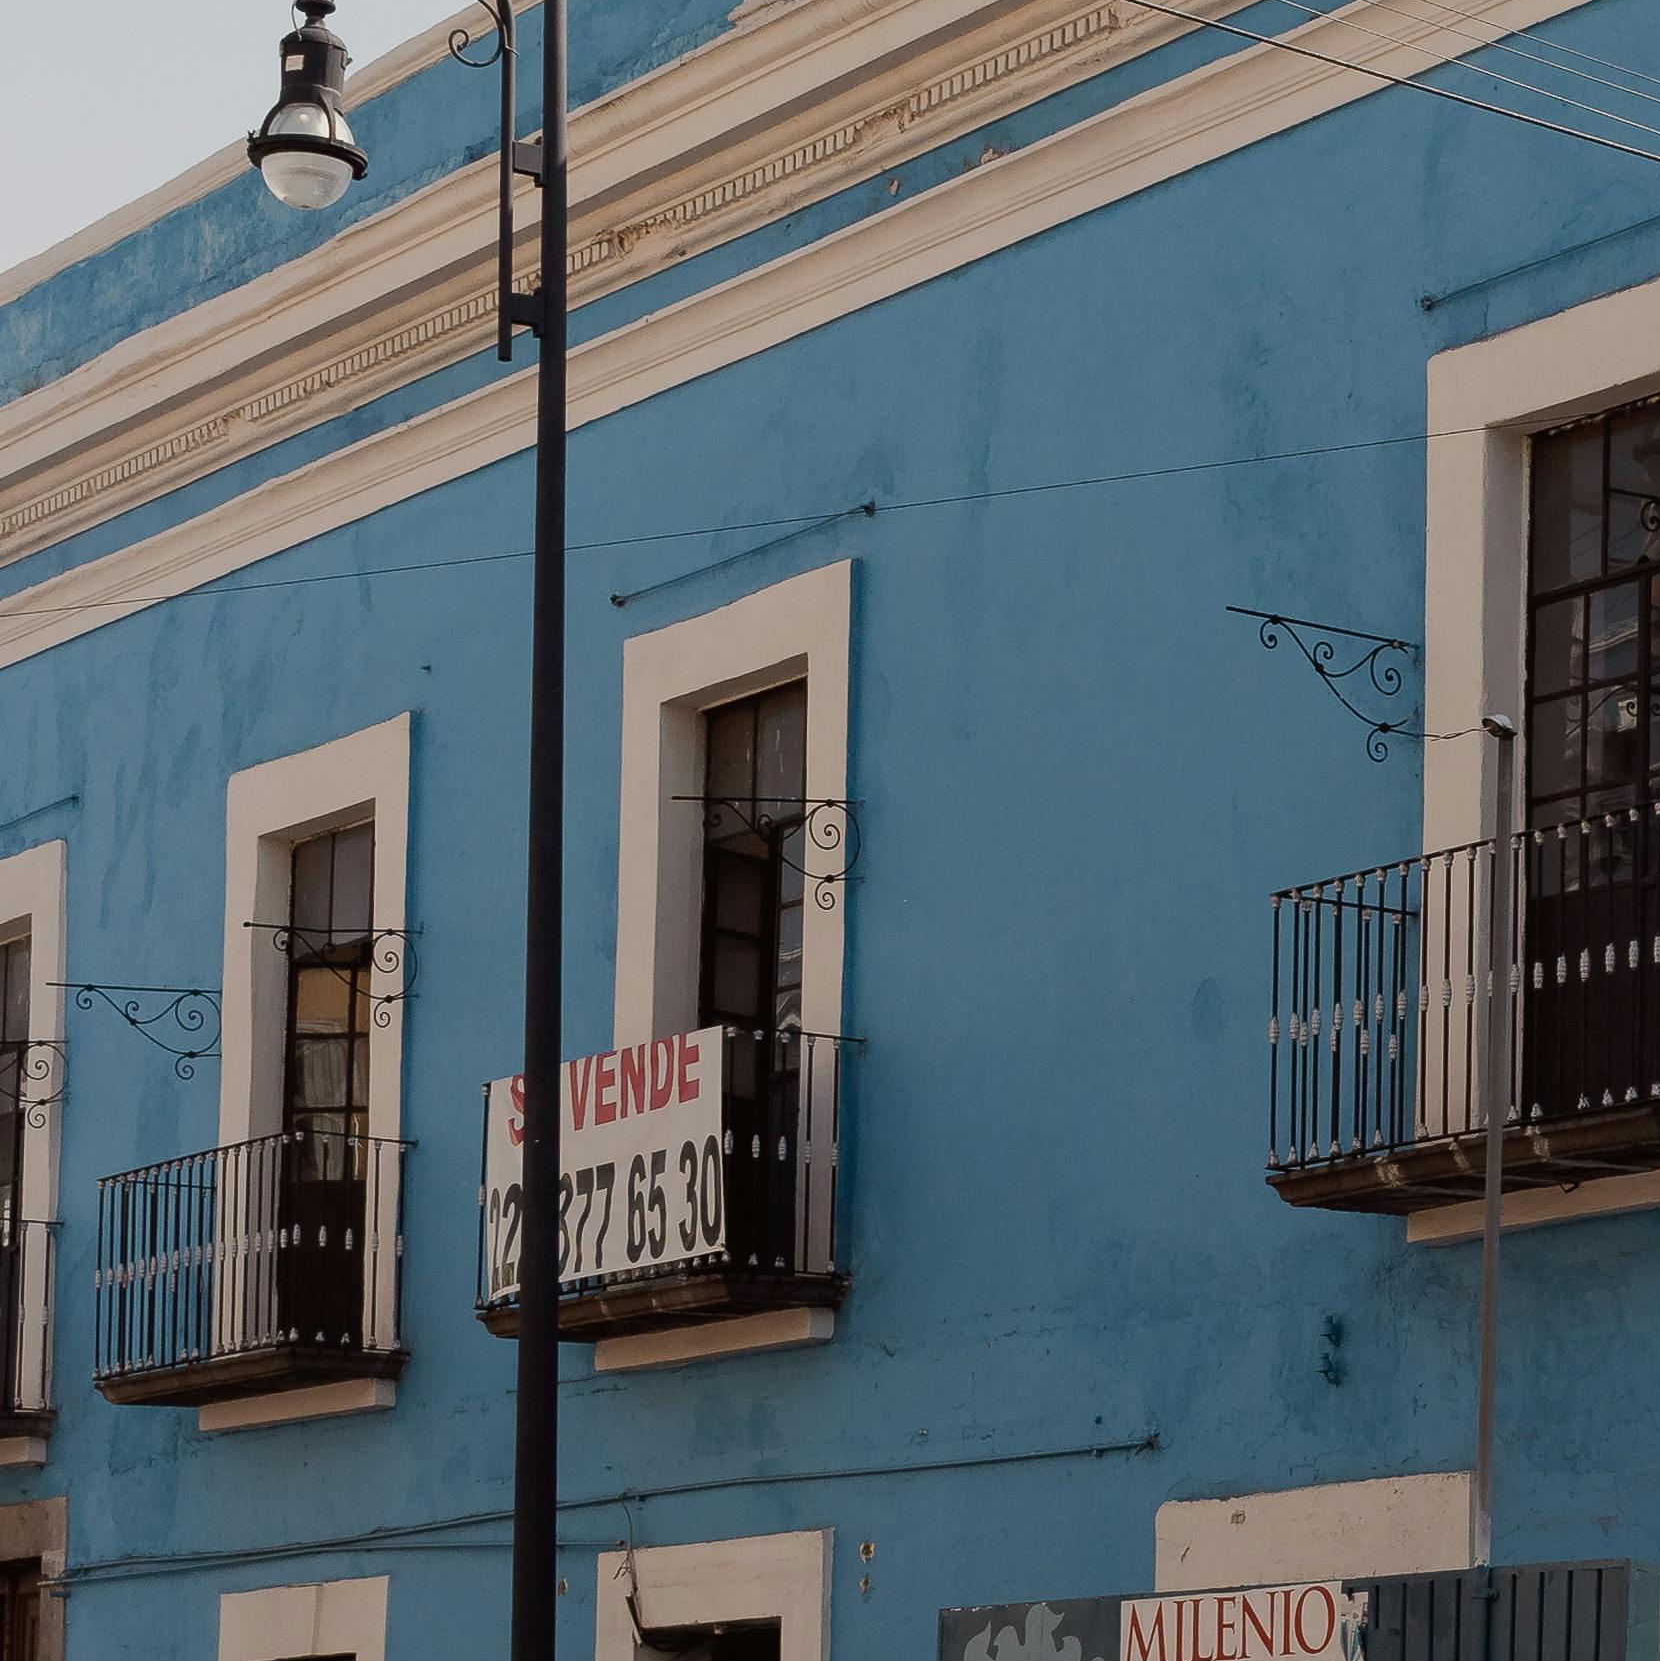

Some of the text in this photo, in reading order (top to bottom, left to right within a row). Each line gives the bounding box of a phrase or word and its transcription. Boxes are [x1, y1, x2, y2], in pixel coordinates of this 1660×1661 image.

[569, 1033, 700, 1132] VENDE
[625, 1148, 668, 1264] 65
[678, 1134, 723, 1252] 30
